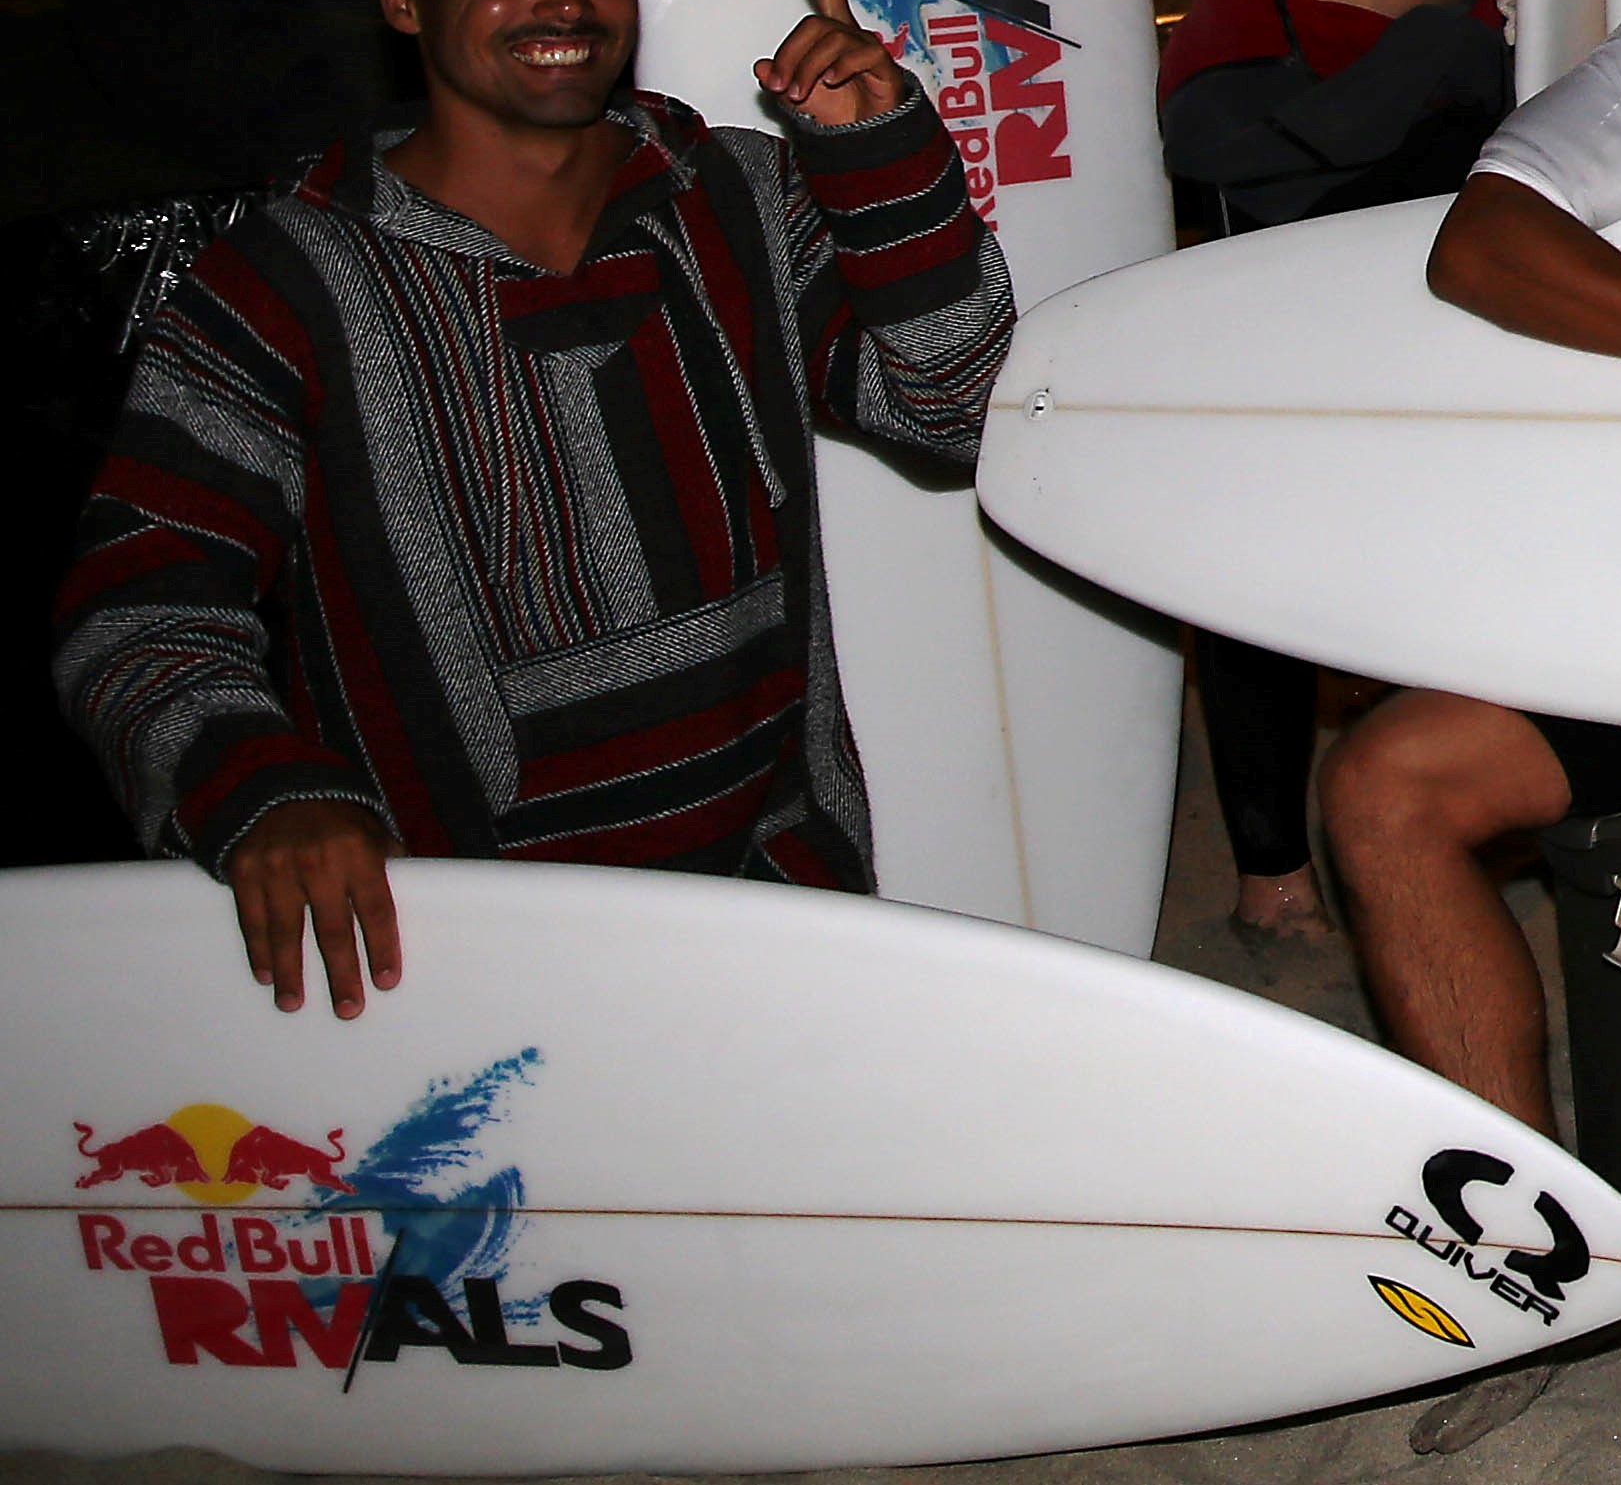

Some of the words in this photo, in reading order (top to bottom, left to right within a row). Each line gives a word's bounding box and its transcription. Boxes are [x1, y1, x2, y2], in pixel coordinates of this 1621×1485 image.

[926, 14, 986, 120] Bull
[77, 1213, 227, 1272] Red
[231, 1215, 375, 1277] Bull
[1384, 1203, 1561, 1328] QUIVER
[148, 1268, 634, 1378] RIVALS
